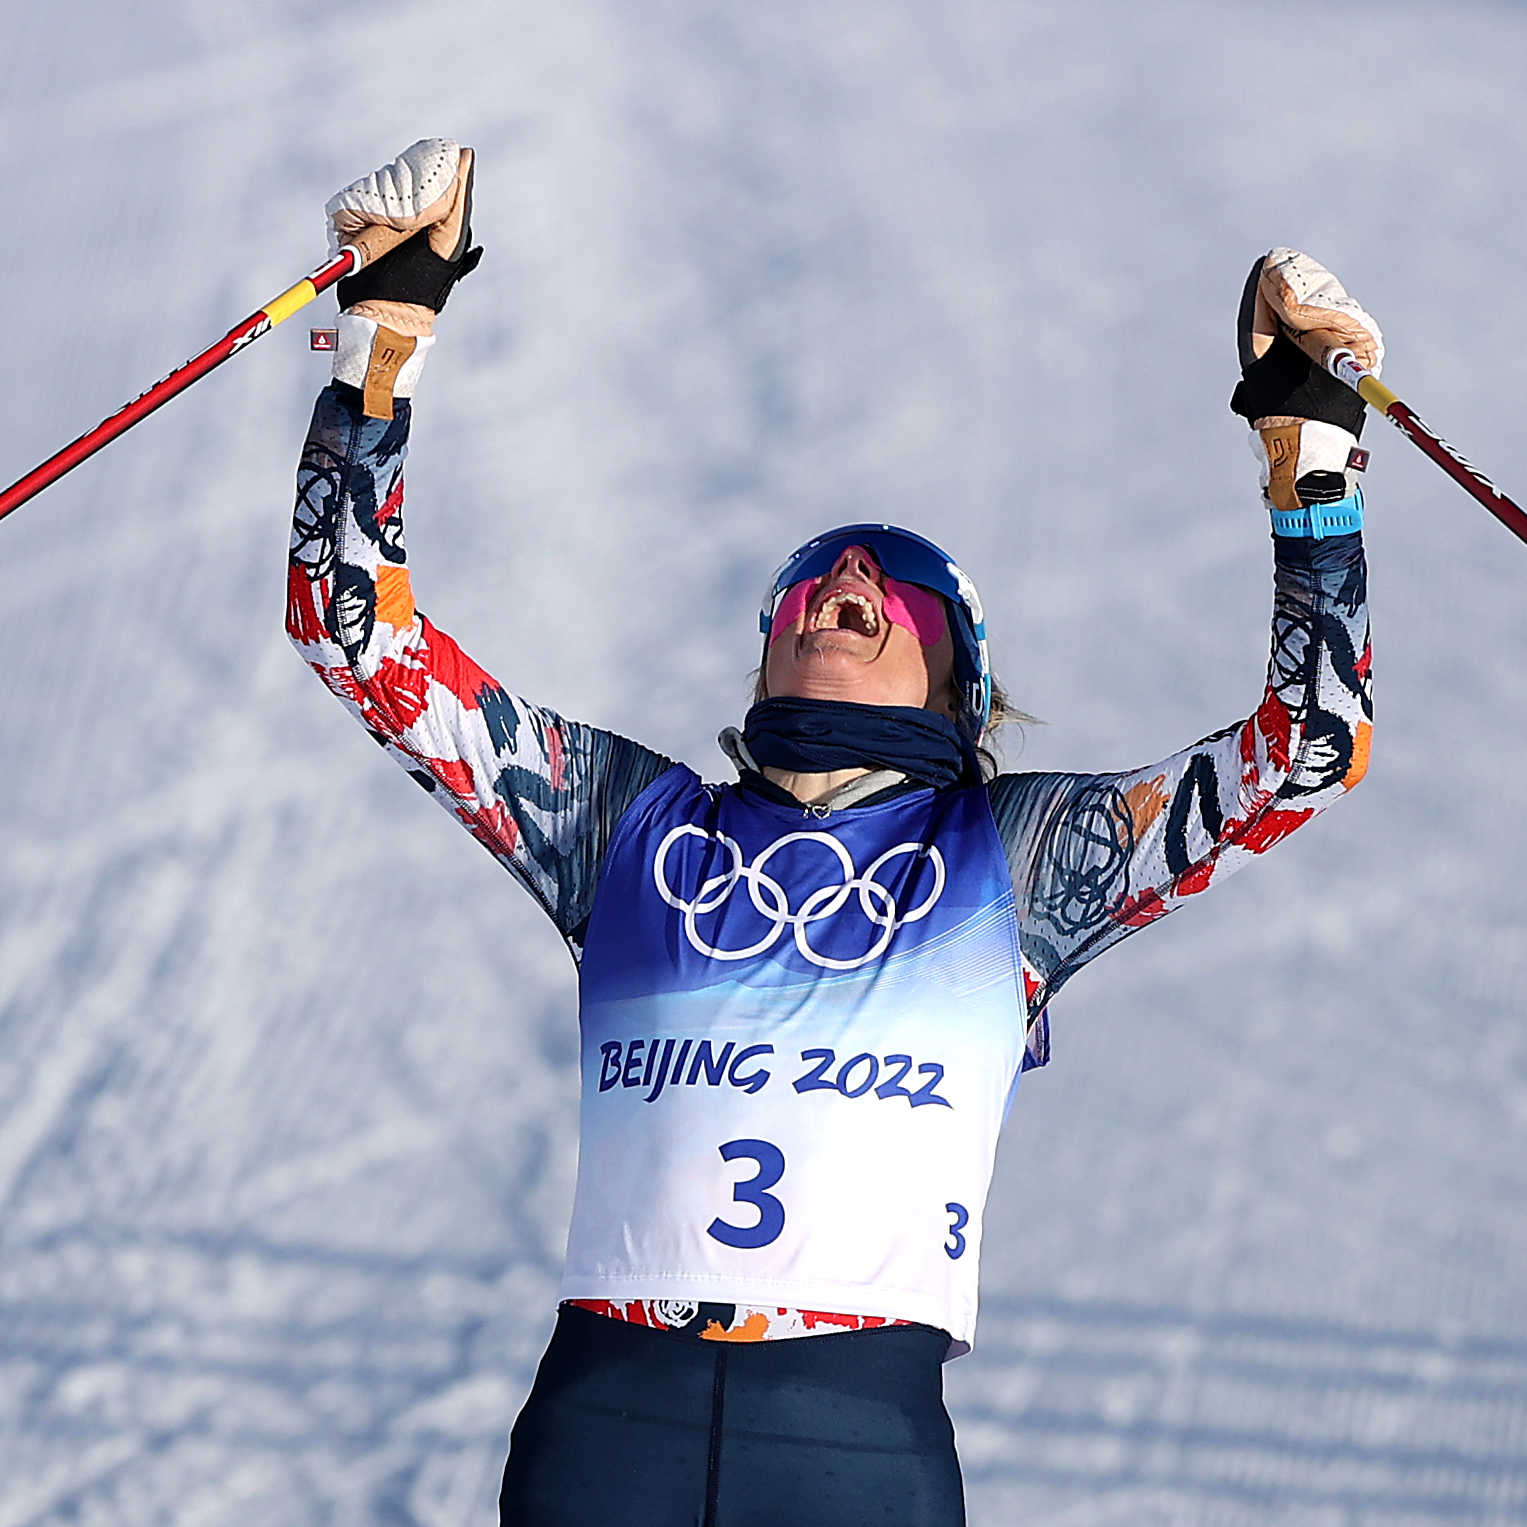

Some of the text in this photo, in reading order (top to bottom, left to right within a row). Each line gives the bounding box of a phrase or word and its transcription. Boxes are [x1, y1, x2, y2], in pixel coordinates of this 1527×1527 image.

[598, 1038, 955, 1110] BEIJING 2022
[706, 1138, 786, 1249] 3
[943, 1202, 970, 1260] 3
